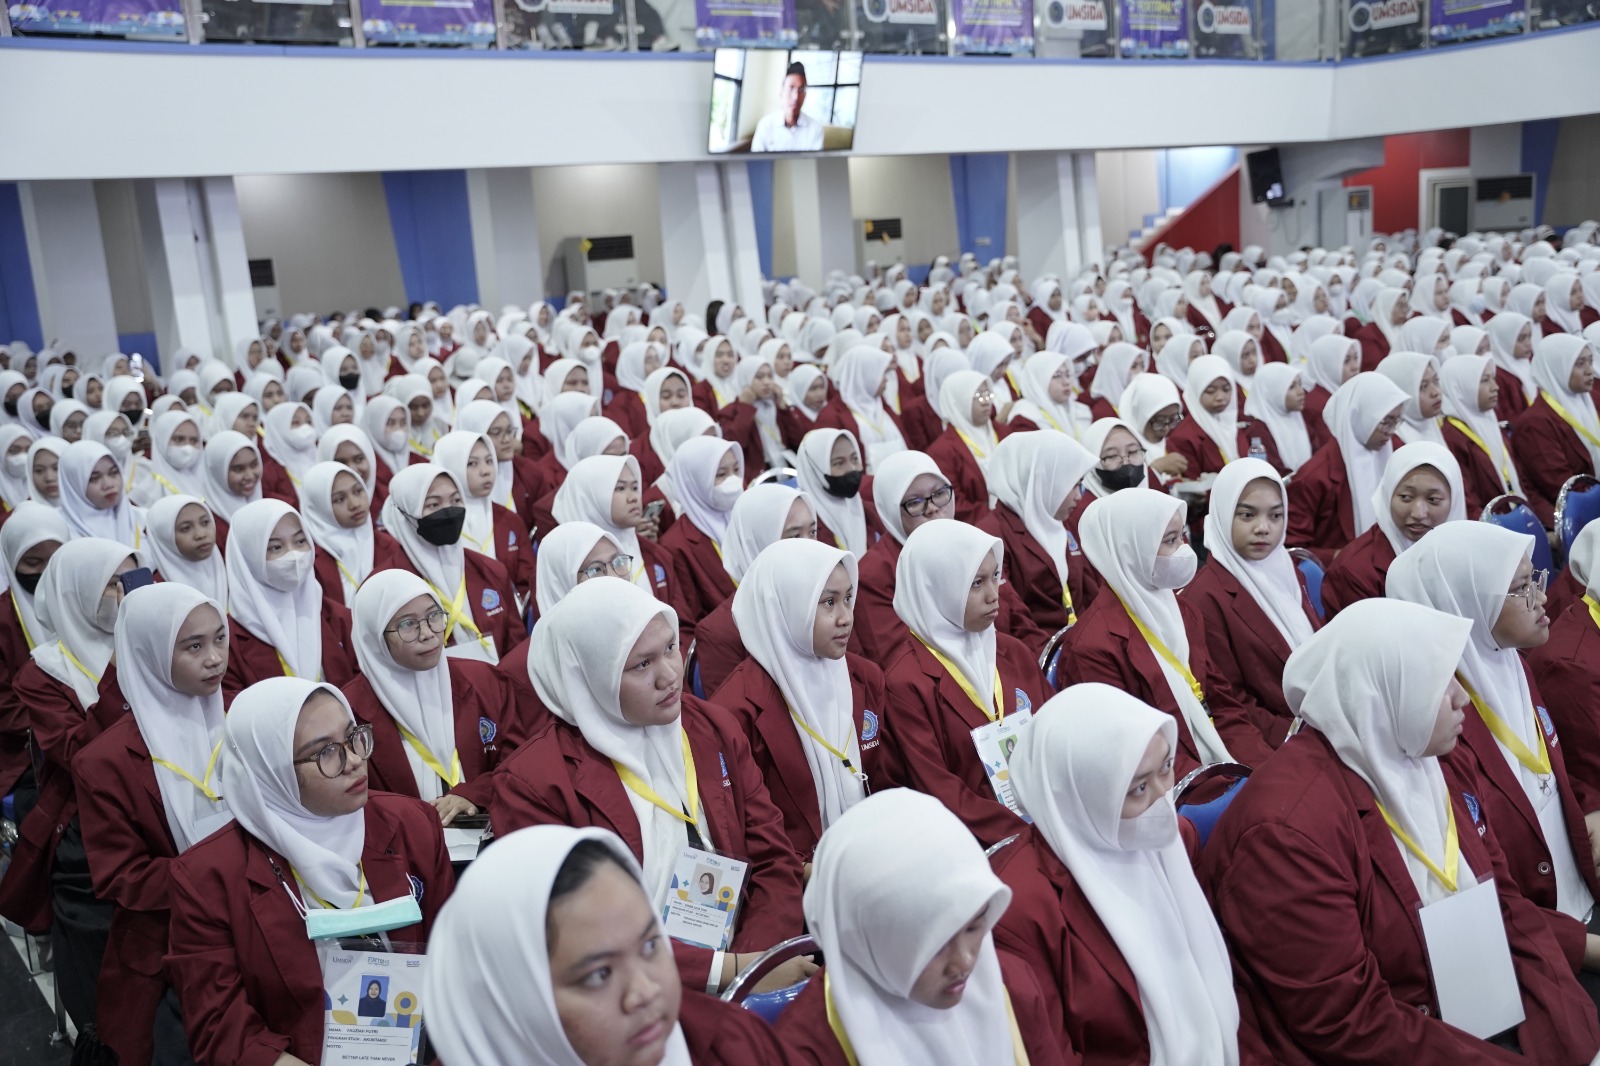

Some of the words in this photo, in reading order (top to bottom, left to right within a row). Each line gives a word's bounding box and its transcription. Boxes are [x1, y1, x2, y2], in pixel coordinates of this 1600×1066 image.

[1065, 4, 1104, 20] UMSIDA
[1216, 10, 1249, 25] UMSIDA
[1372, 0, 1417, 21] UMSIDA
[861, 739, 880, 751] UMSIDA
